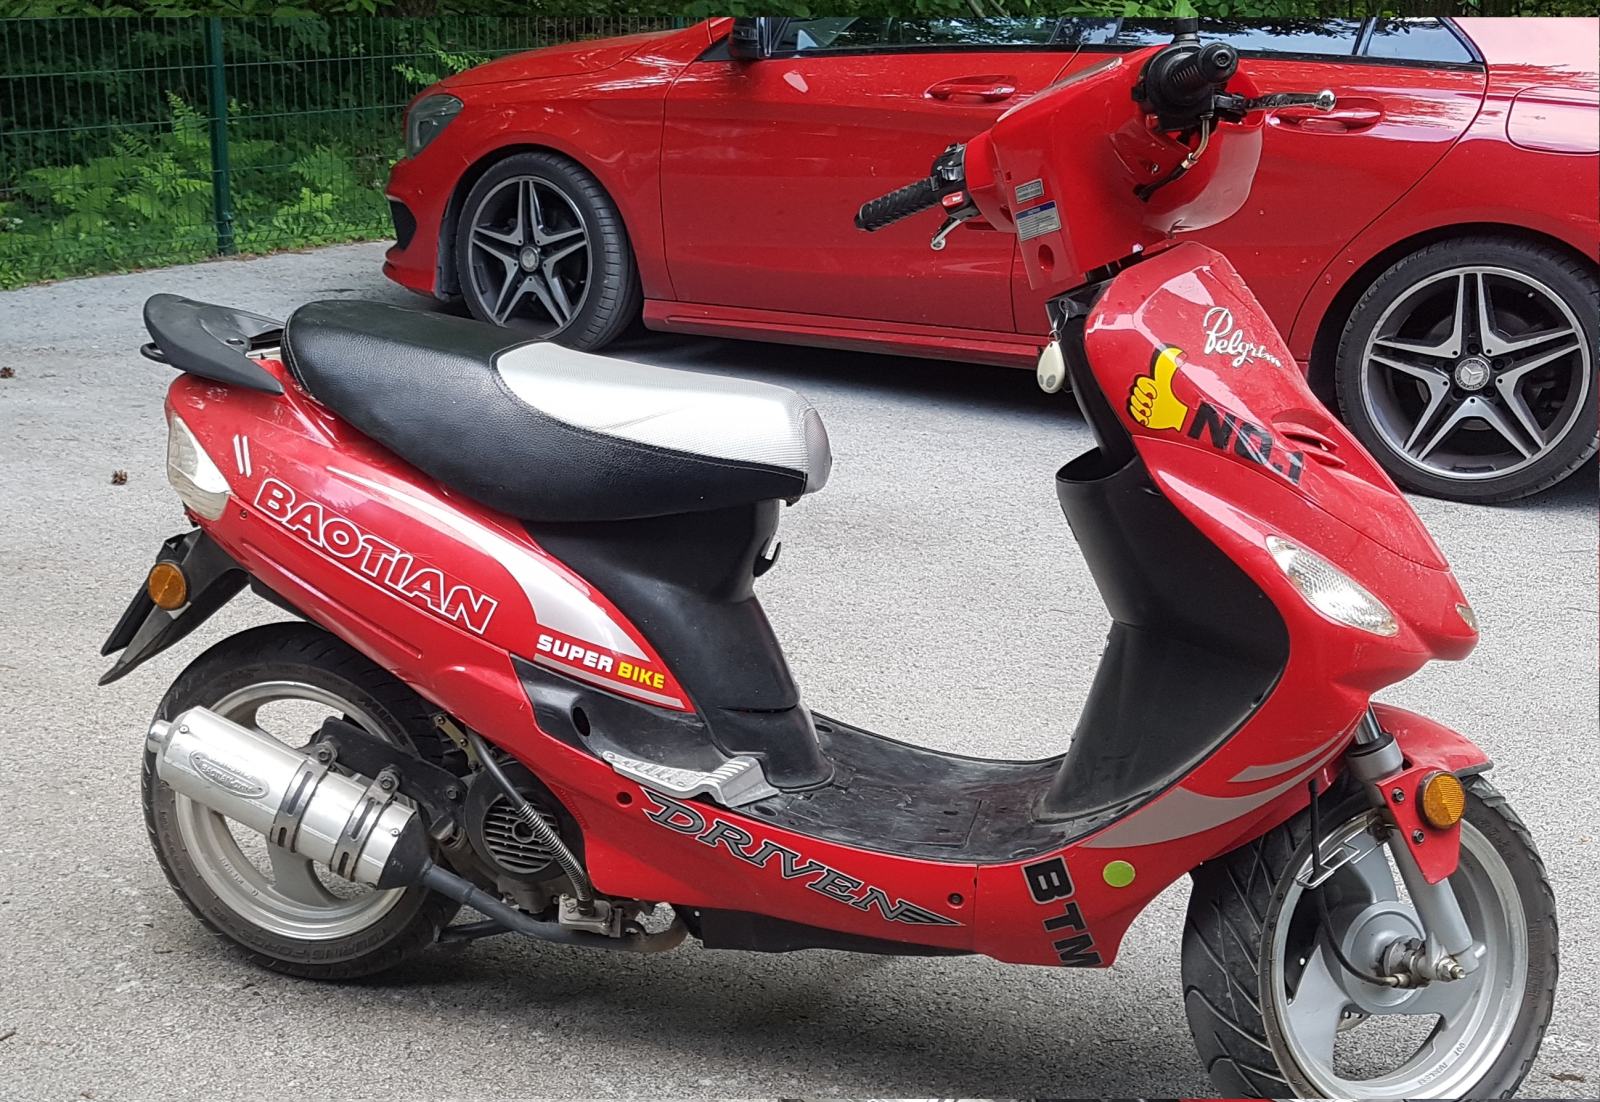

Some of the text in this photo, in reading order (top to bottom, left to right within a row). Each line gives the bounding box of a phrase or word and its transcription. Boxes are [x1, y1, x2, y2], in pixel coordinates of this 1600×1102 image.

[253, 478, 498, 634] BAOTIAN
[536, 635, 666, 689] SUPER BIKE
[641, 788, 965, 925] DRIVEN
[1022, 856, 1102, 967] BTM
